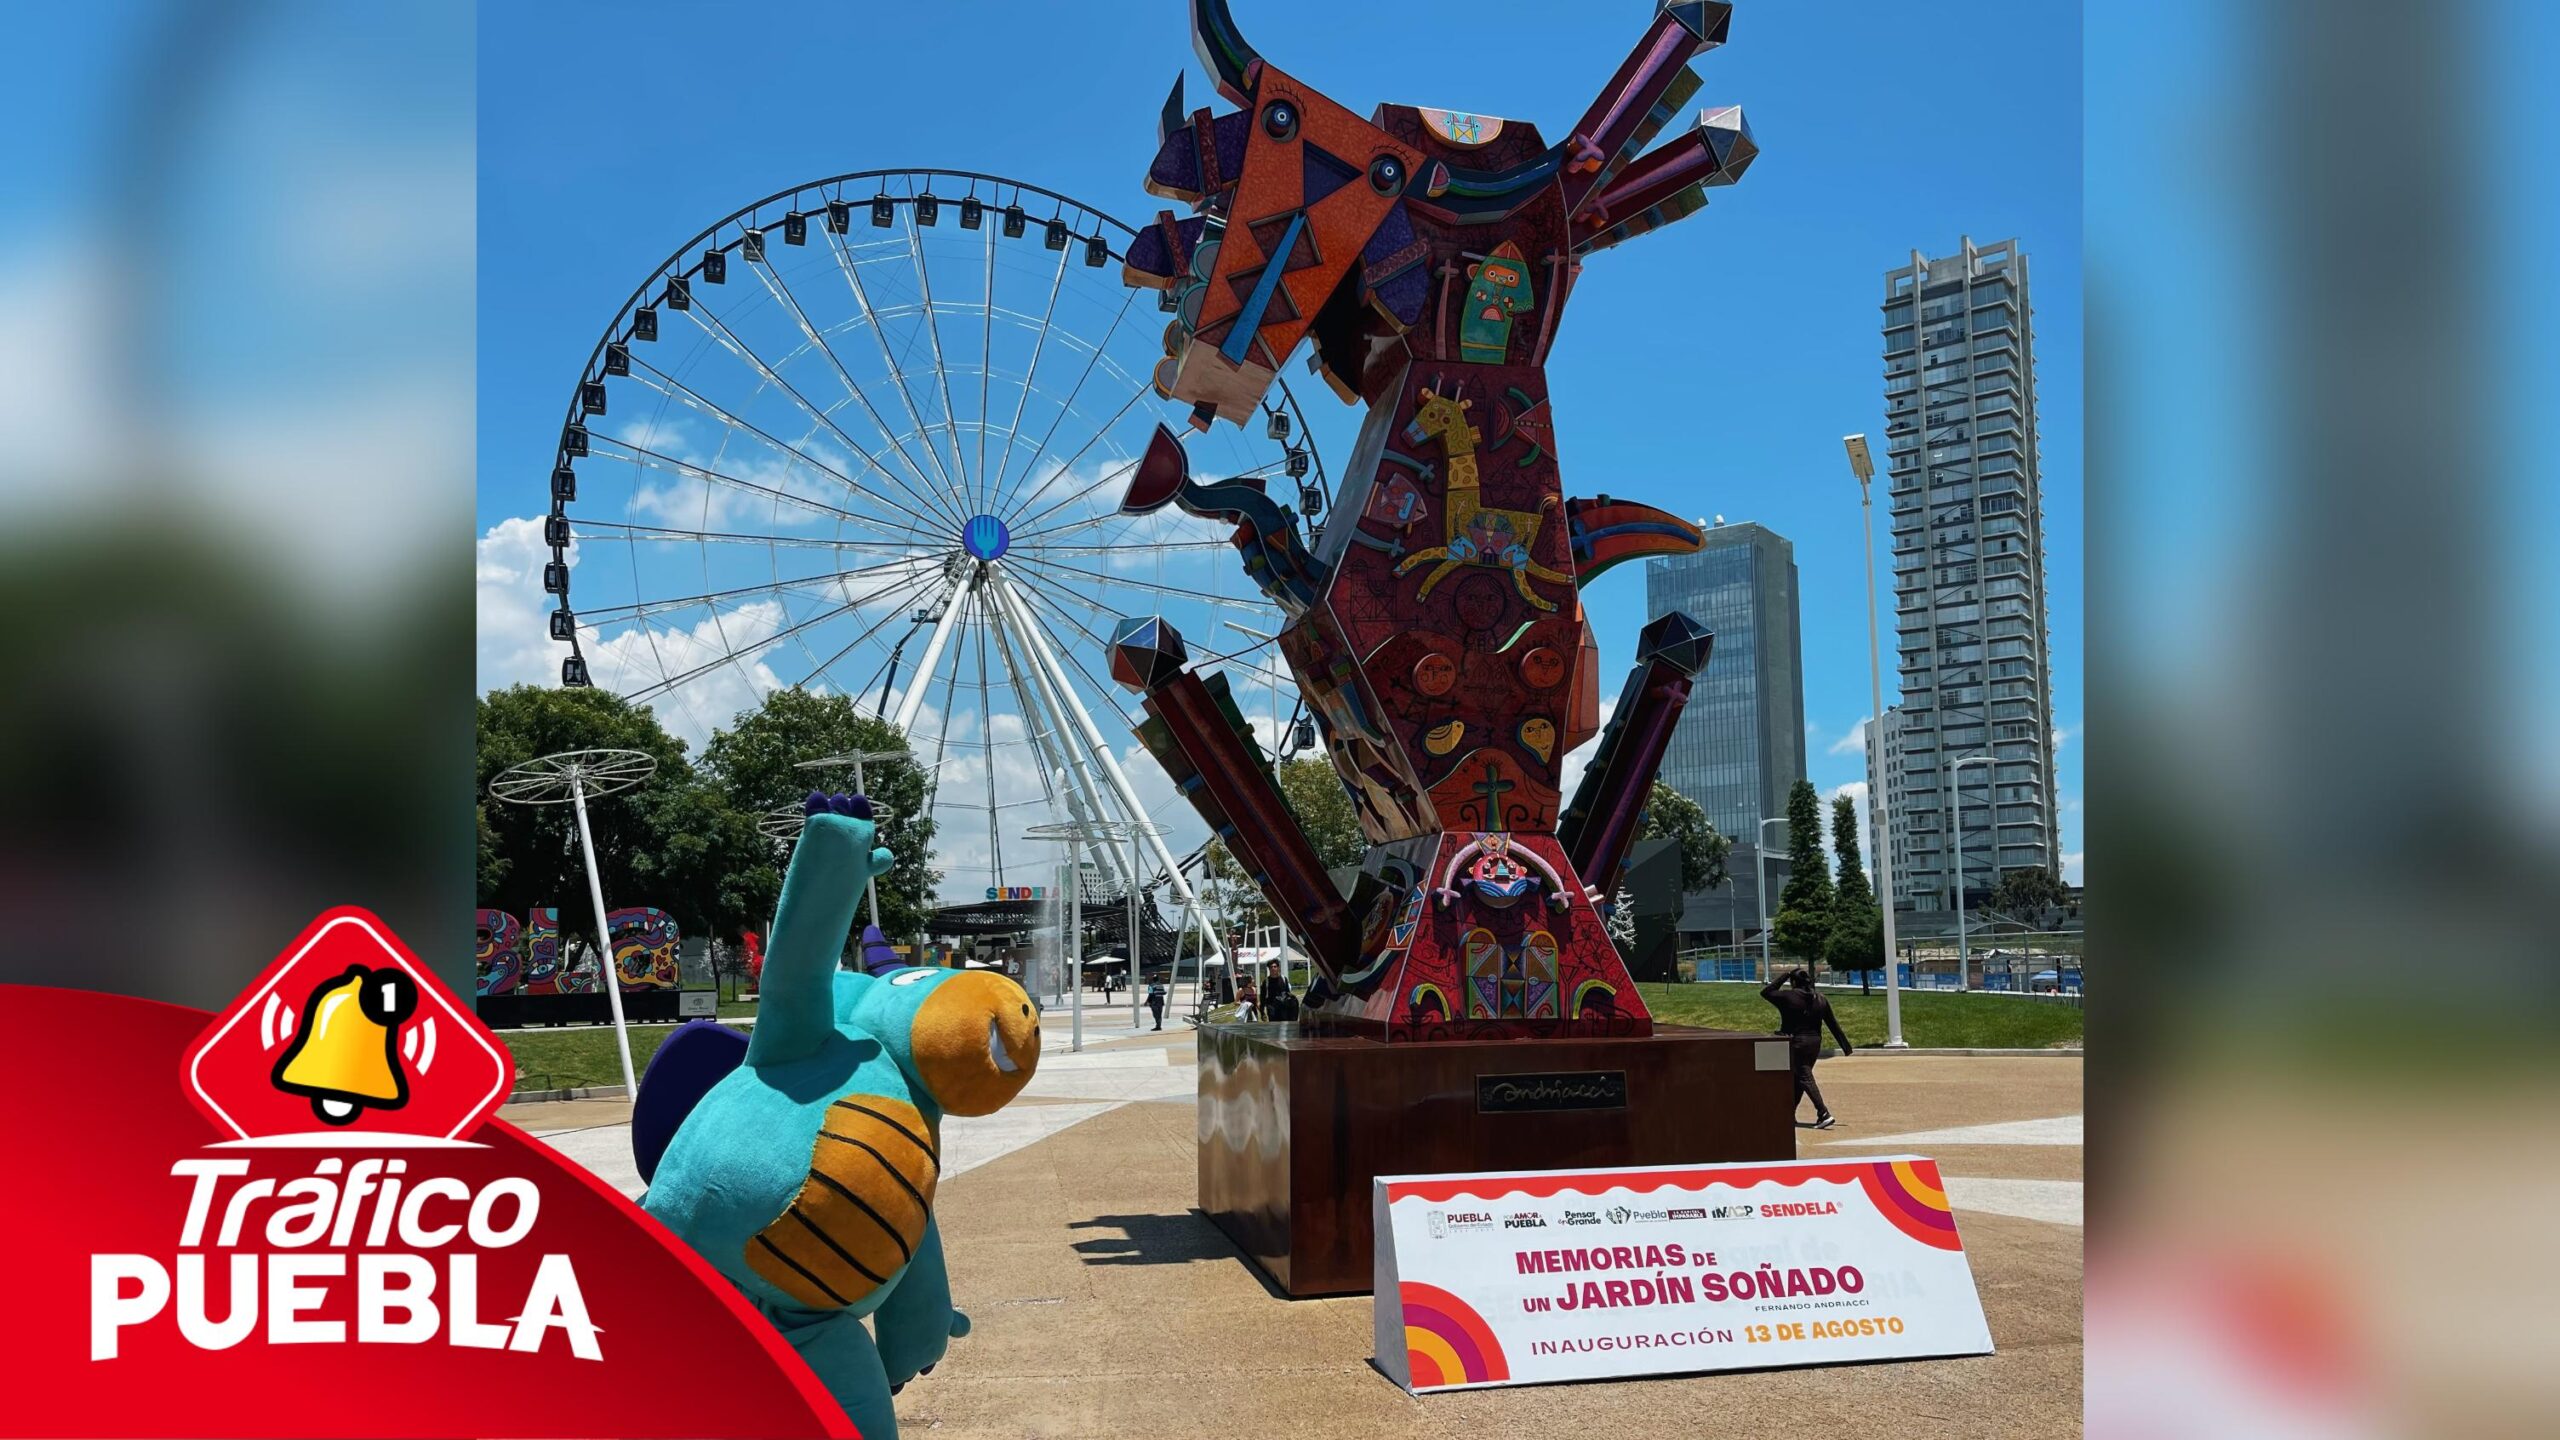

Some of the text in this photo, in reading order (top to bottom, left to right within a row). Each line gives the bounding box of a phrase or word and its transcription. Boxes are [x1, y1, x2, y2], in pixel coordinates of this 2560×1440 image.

[1564, 1210, 1597, 1219] Pensar
[1760, 1201, 1838, 1218] SENDELA
[1447, 1213, 1493, 1224] PUEBLA
[1504, 1219, 1547, 1229] PUEBLA
[1567, 1217, 1601, 1226] Grande
[1515, 1243, 1687, 1275] MEMORIAS
[1692, 1252, 1717, 1267] DE
[1523, 1297, 1551, 1313] UN
[1556, 1271, 1695, 1311] JARDÍN
[1703, 1262, 1865, 1303] SOÑADO
[1754, 1299, 1870, 1313] FERNANDO ANDRIACCI
[1531, 1316, 1904, 1355] INAUGURACIÓN 13 DE AGOSTO
